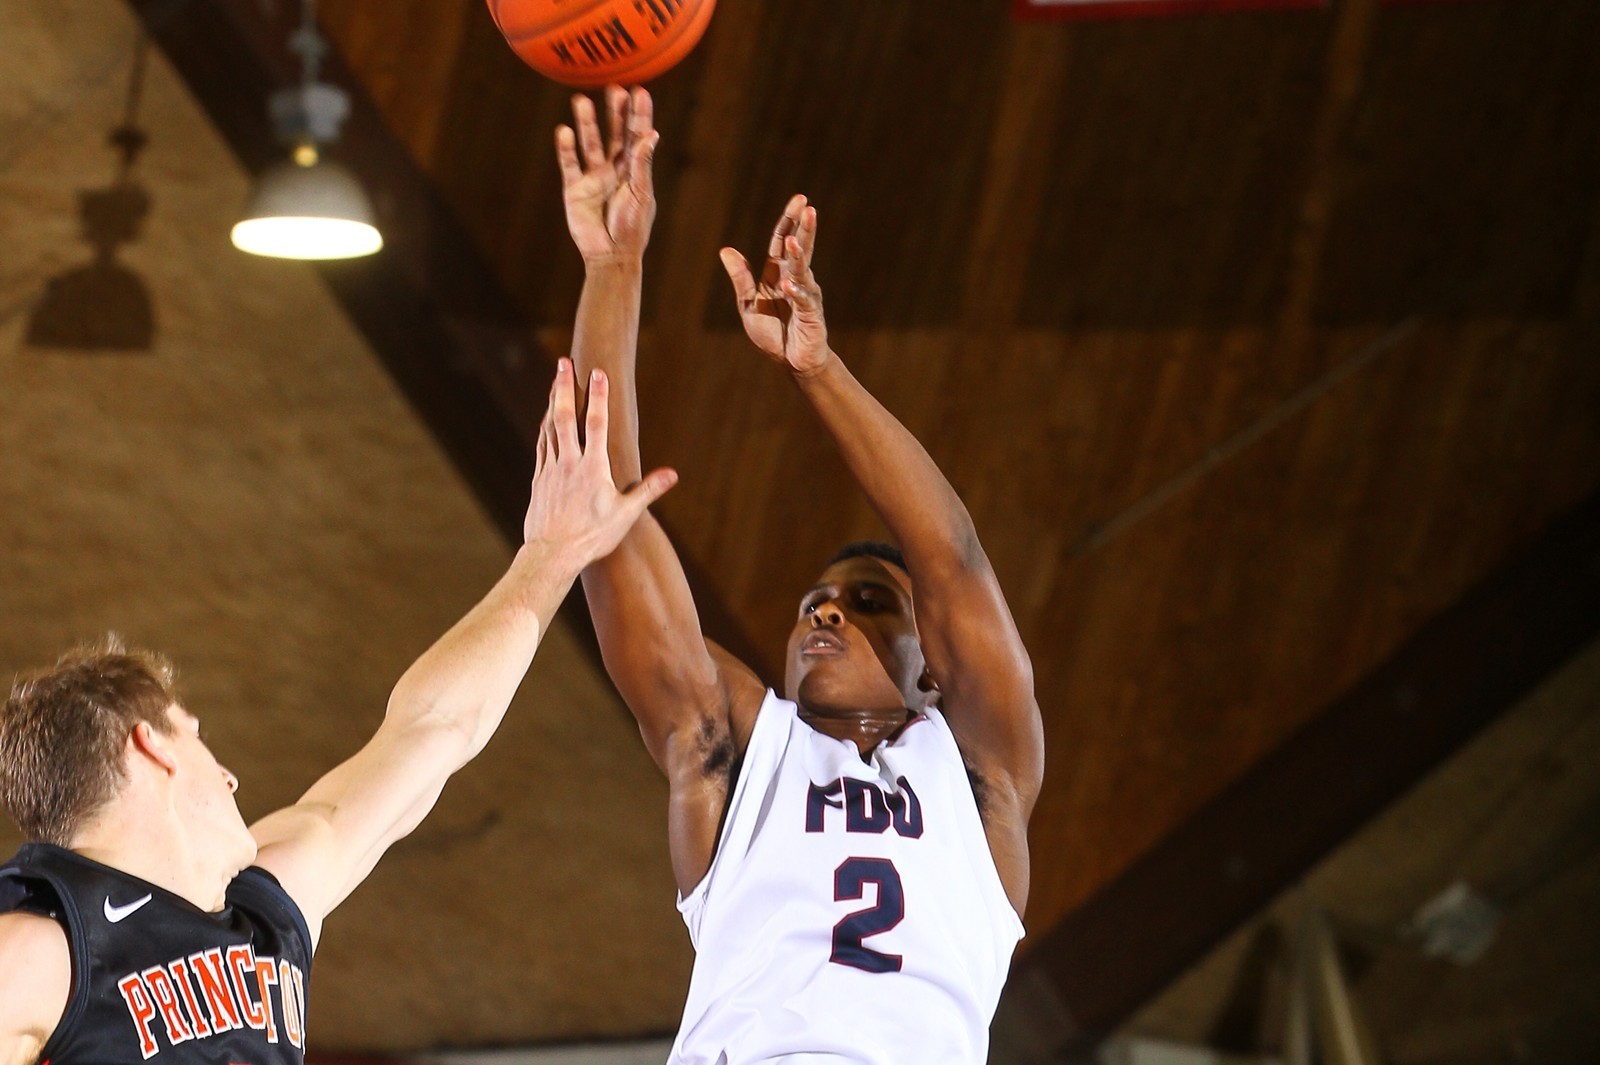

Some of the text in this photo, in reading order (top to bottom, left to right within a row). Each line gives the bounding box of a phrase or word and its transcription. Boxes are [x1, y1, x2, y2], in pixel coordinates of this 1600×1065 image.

[805, 776, 924, 840] FDU
[829, 856, 905, 974] 2
[117, 943, 306, 1060] PRINCTO
